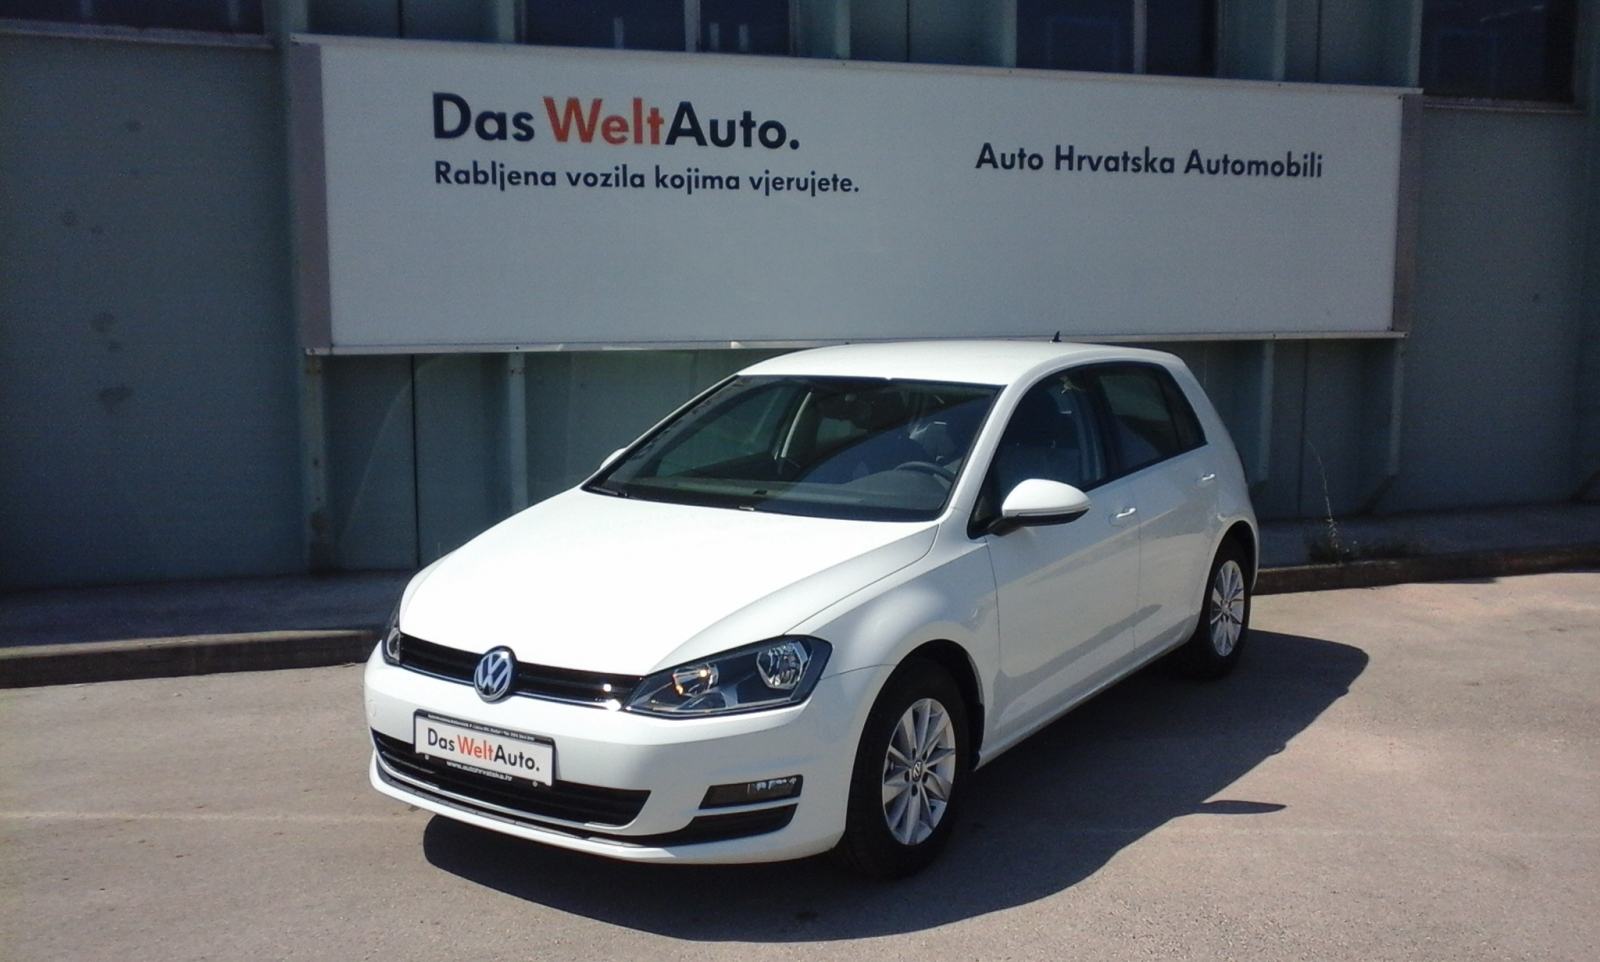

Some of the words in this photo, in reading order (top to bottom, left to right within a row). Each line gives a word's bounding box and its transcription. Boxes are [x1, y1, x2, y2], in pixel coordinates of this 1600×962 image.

[432, 91, 535, 143] Das
[543, 96, 800, 151] WeltAuto.
[434, 159, 557, 192] Rabljena
[565, 163, 645, 189] vozila
[654, 164, 740, 195] kojima
[749, 170, 860, 198] vjerujete.
[976, 142, 1044, 171] Auto
[1055, 144, 1175, 174] Hrvatska
[1184, 149, 1323, 178] Automobili
[474, 651, 512, 700] VW
[427, 727, 455, 752] Das
[456, 734, 540, 772] WeltAuto.
